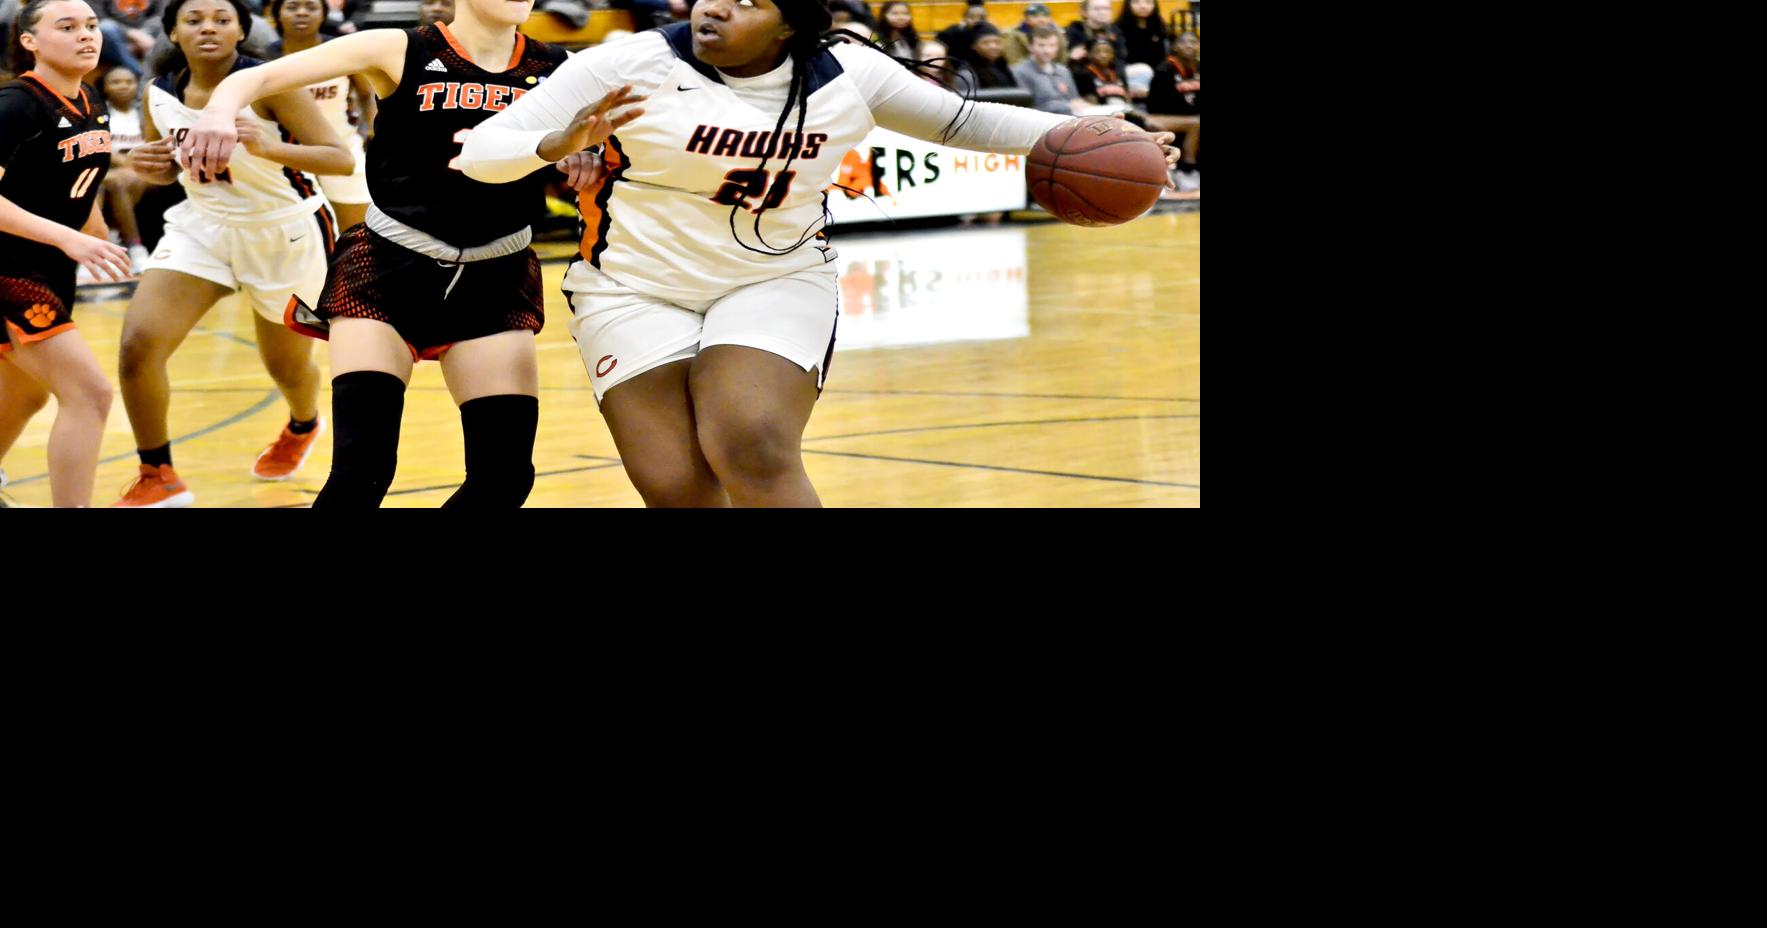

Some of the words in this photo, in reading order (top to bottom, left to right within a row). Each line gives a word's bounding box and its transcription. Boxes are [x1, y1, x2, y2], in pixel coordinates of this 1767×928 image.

[685, 124, 829, 160] HAWKS
[954, 153, 1020, 174] HIGH
[709, 167, 797, 215] 21
